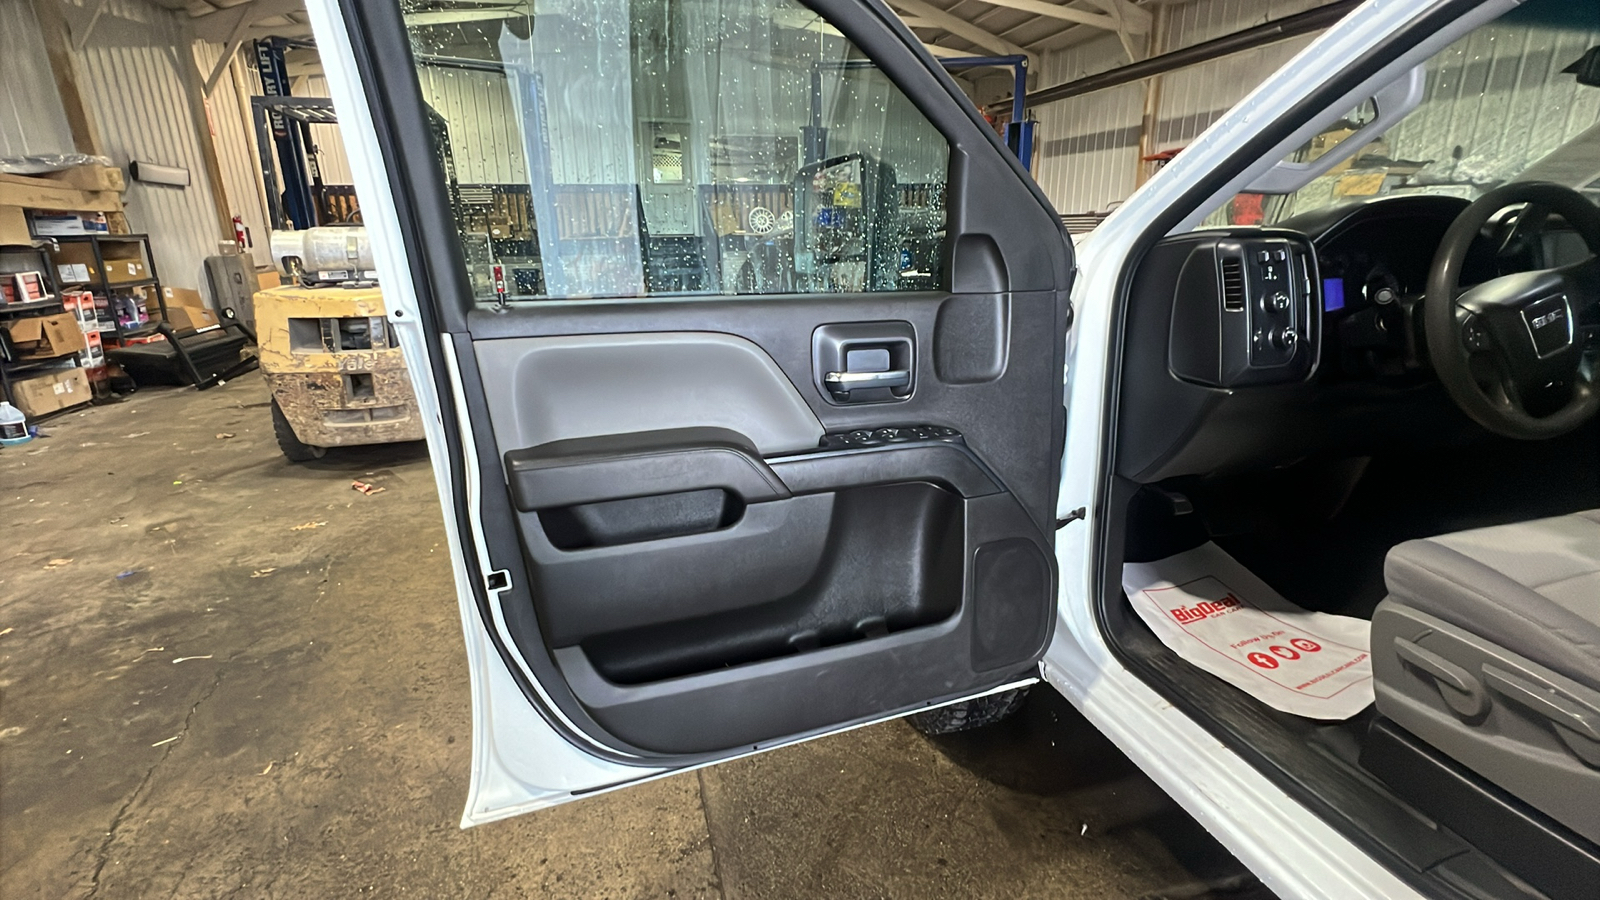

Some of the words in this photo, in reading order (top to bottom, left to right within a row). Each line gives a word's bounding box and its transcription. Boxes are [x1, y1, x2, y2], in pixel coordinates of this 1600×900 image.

[257, 45, 274, 74] LIFT
[263, 76, 285, 130] RORY
[1170, 592, 1242, 624] BigDeal
[1230, 637, 1260, 650] Follow
